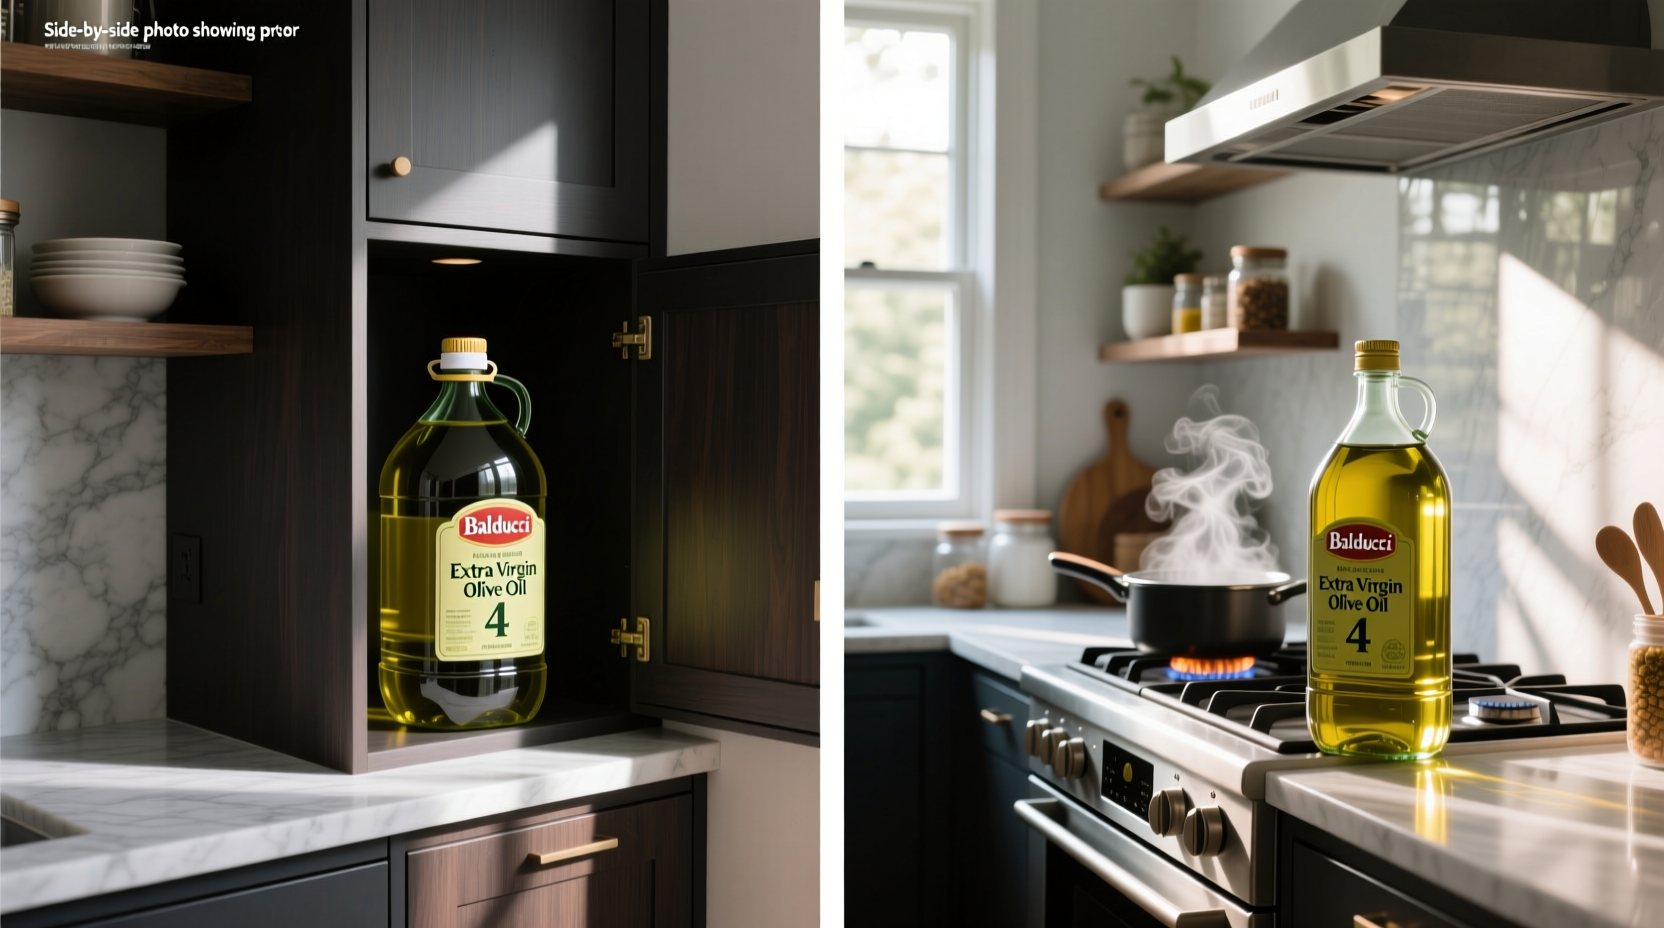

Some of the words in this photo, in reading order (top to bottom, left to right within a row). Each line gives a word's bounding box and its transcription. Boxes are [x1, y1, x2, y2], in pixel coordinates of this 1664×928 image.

[463, 515, 530, 535] Balducci
[1329, 531, 1393, 551] Balducci
[450, 562, 493, 579] Extra
[496, 560, 537, 580] Virgin
[463, 581, 503, 598] Olive
[1319, 575, 1354, 592] Extra
[1356, 578, 1403, 597] Virgin
[1328, 593, 1363, 611] Olive
[1366, 595, 1388, 612] Oil
[484, 601, 510, 638] 4
[1345, 617, 1372, 653] 4
